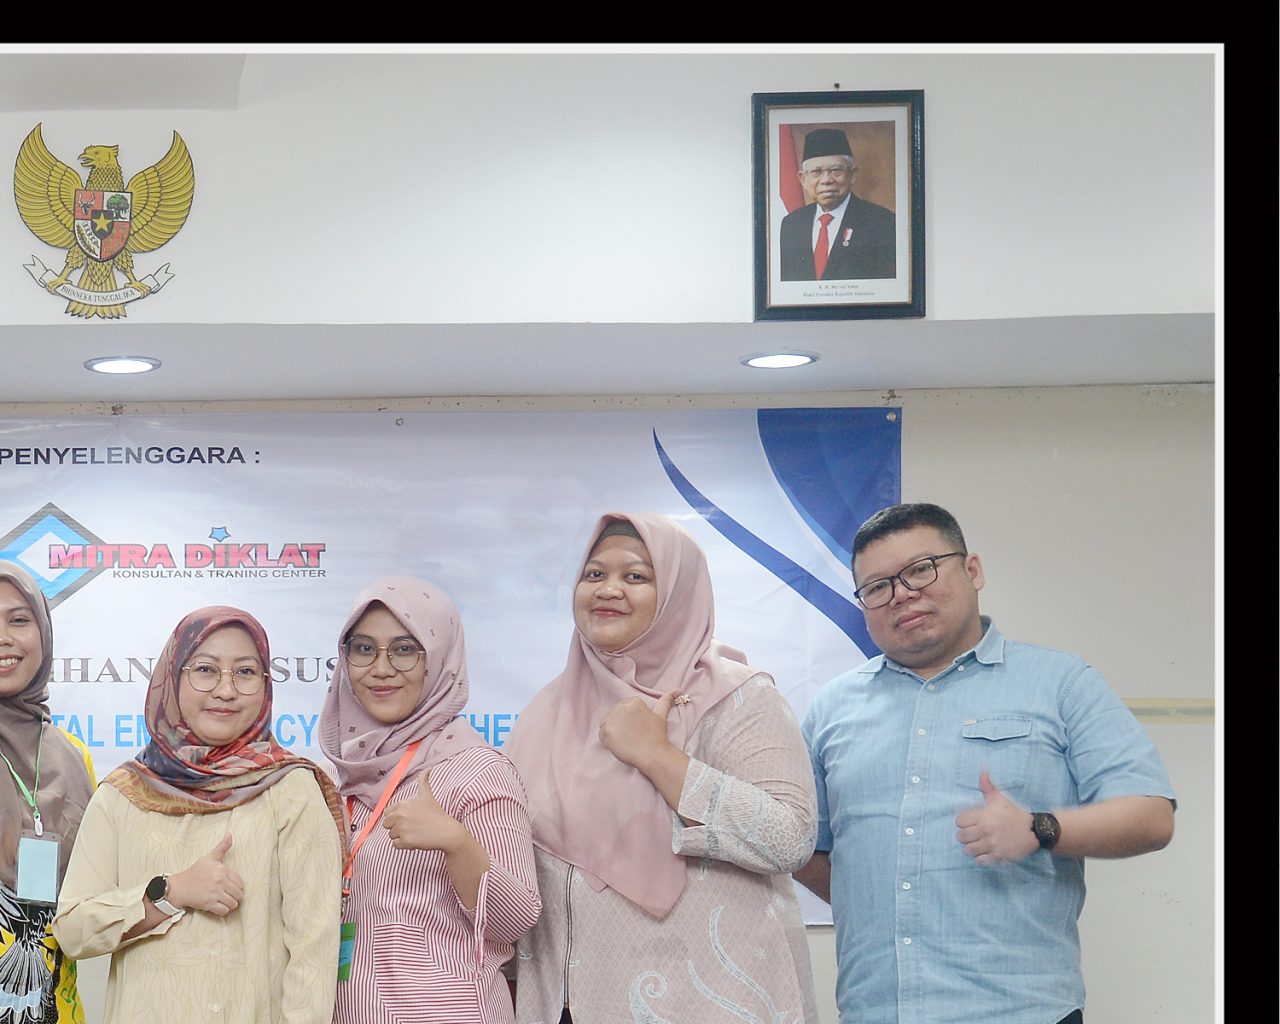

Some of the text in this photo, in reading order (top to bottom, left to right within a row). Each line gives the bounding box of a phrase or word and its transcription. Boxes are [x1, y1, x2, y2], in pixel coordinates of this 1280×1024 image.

[48, 544, 326, 569] MITRA DIKLAT
[113, 569, 327, 579] KONSULTAN & TRANING CENTER
